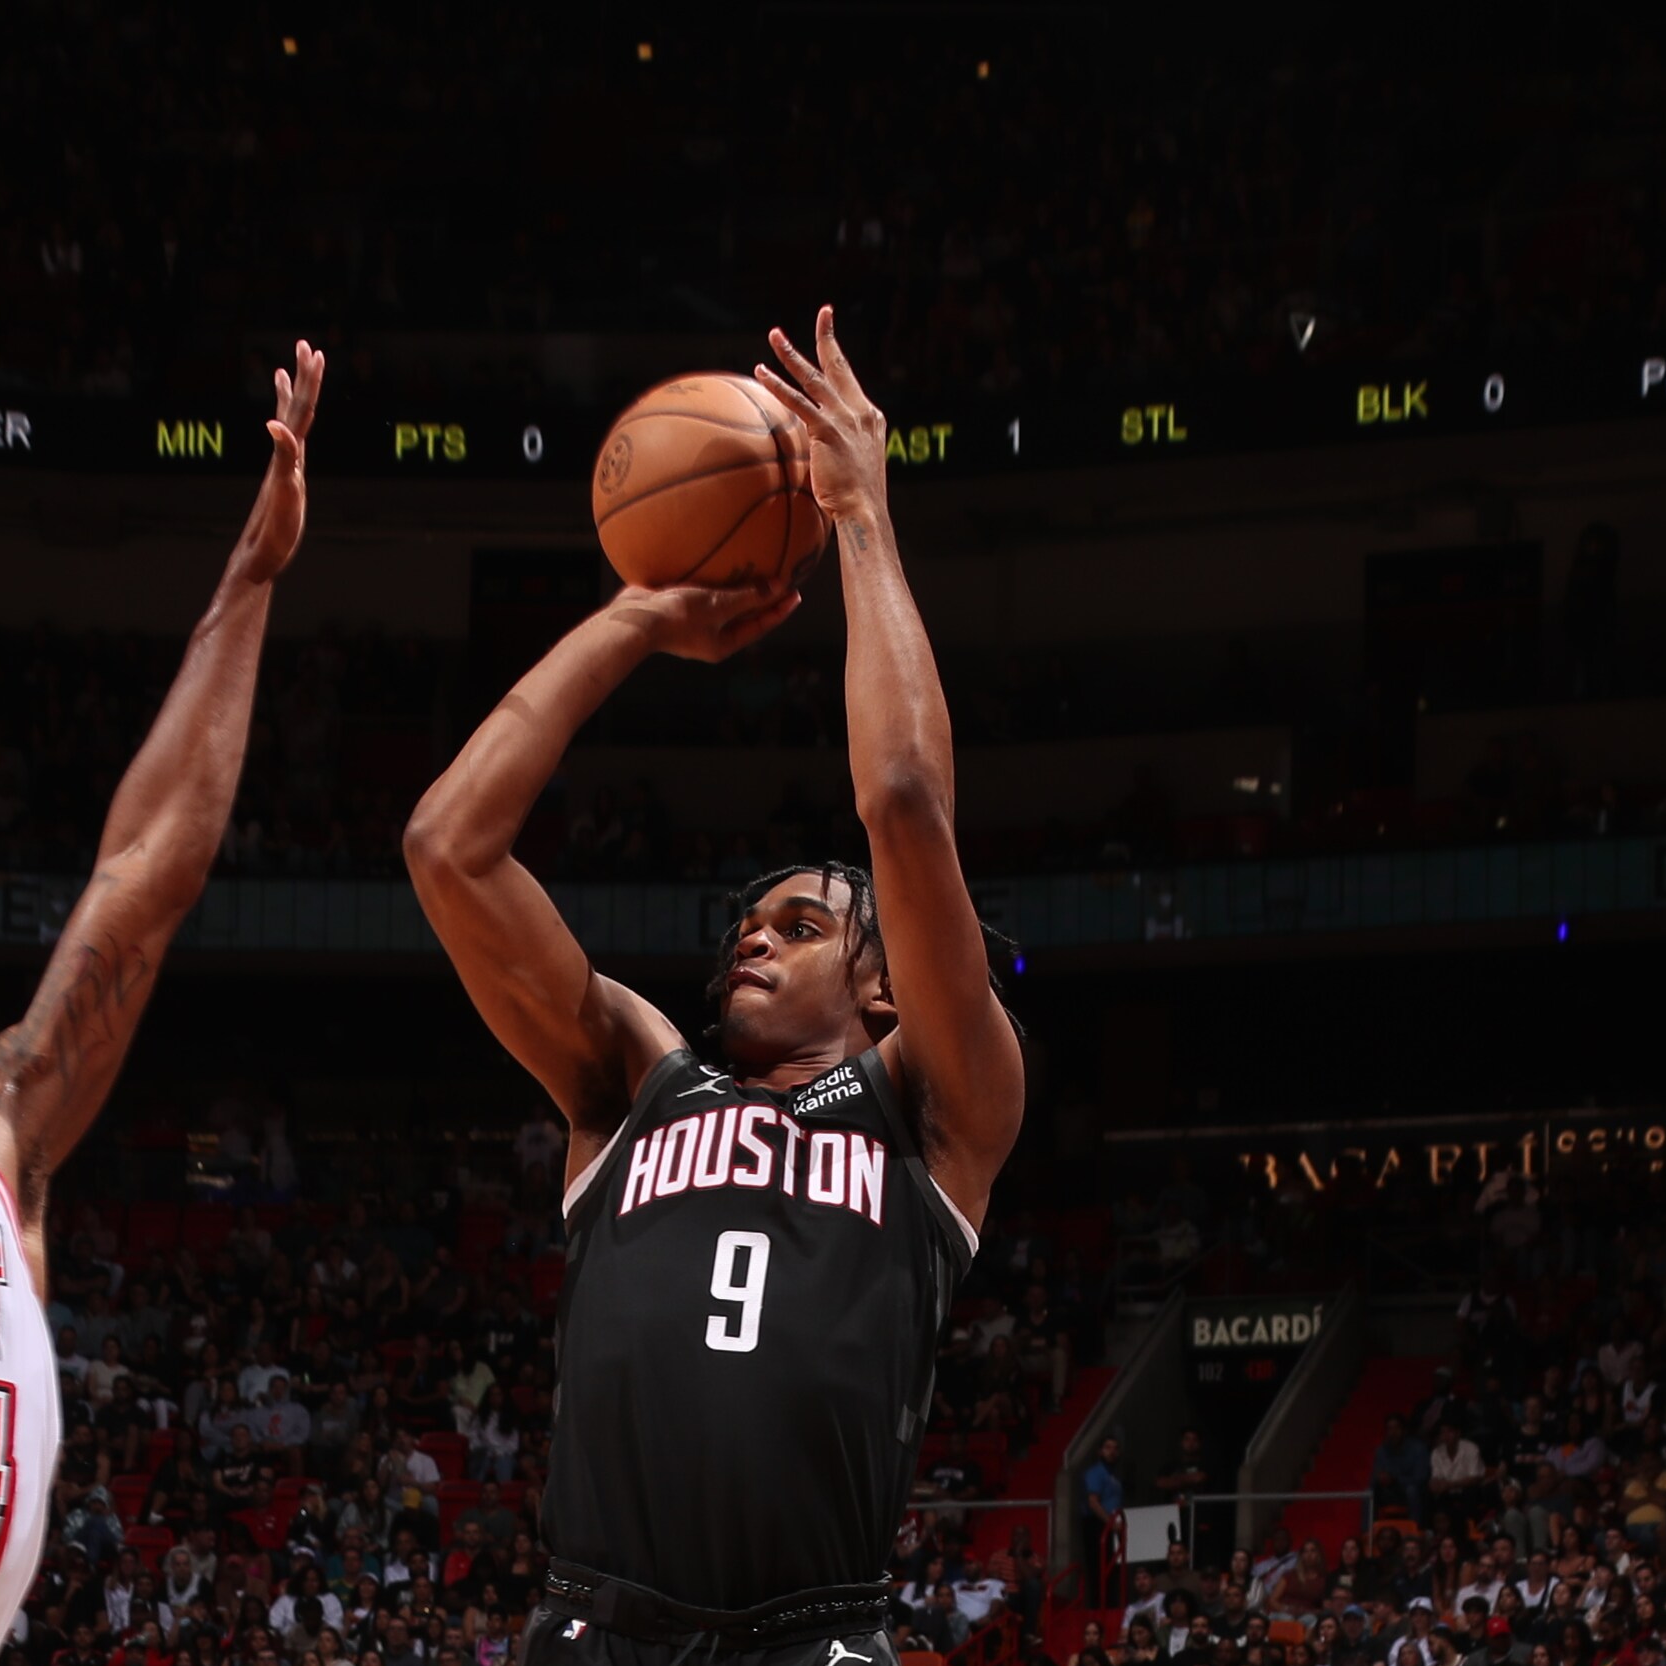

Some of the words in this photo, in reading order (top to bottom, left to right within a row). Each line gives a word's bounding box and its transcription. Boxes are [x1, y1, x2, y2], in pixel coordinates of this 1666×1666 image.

[156, 418, 225, 461] MIN
[394, 421, 467, 463] PTS
[522, 424, 544, 464] 0
[885, 424, 953, 466] AST
[1008, 416, 1021, 457] 1
[1119, 404, 1188, 447] STL
[1355, 380, 1430, 426] BLK
[1483, 373, 1505, 414] 0
[793, 1066, 855, 1101] credit
[793, 1079, 864, 1116] karma
[617, 1104, 888, 1229] HOUSTON
[705, 1230, 772, 1353] 9
